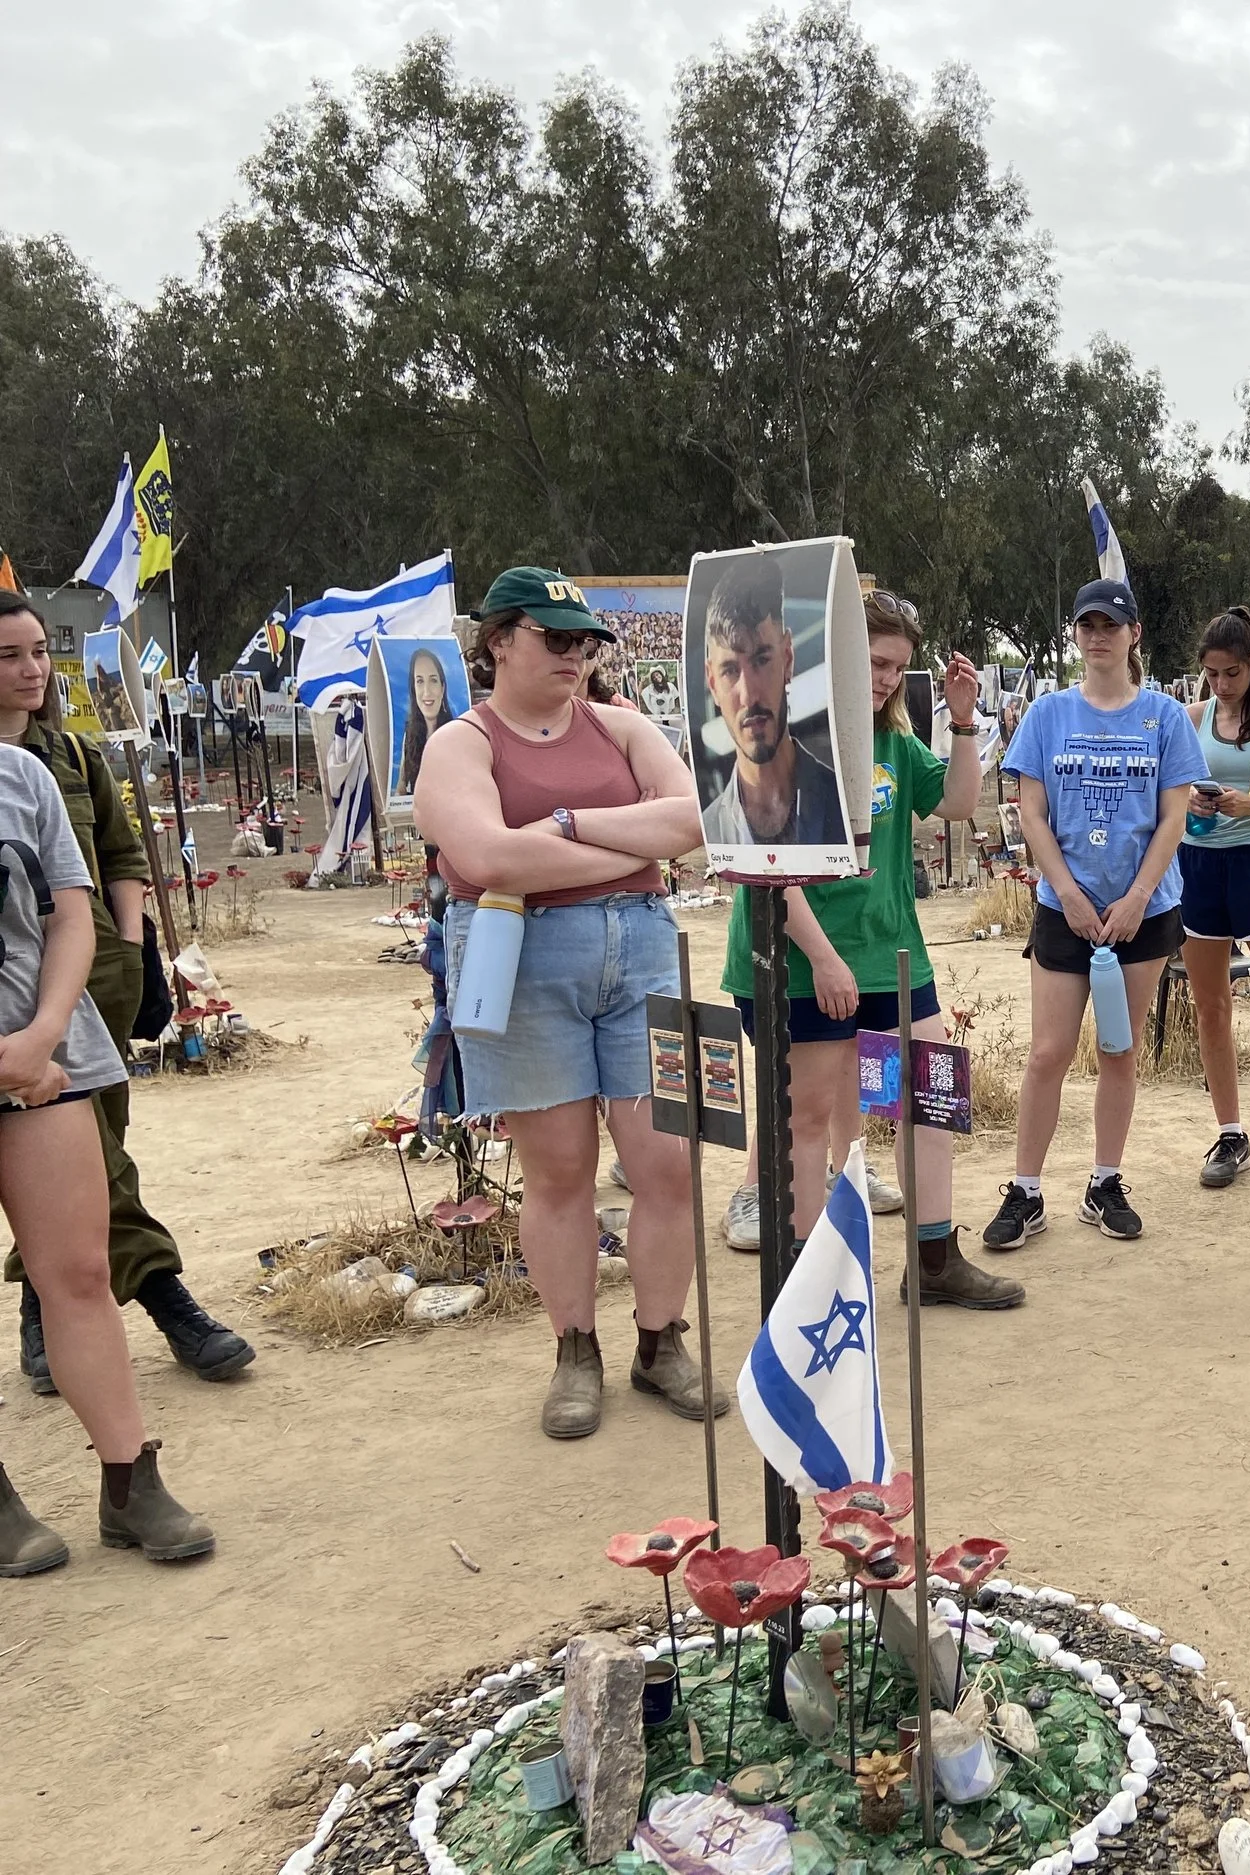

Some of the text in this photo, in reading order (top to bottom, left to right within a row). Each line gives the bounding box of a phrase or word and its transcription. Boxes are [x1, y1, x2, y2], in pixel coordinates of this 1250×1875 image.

[1068, 744, 1098, 752] NORTH
[1053, 753, 1158, 778] CUT THE NET
[711, 853, 721, 864] Guy
[825, 855, 838, 864] עזר
